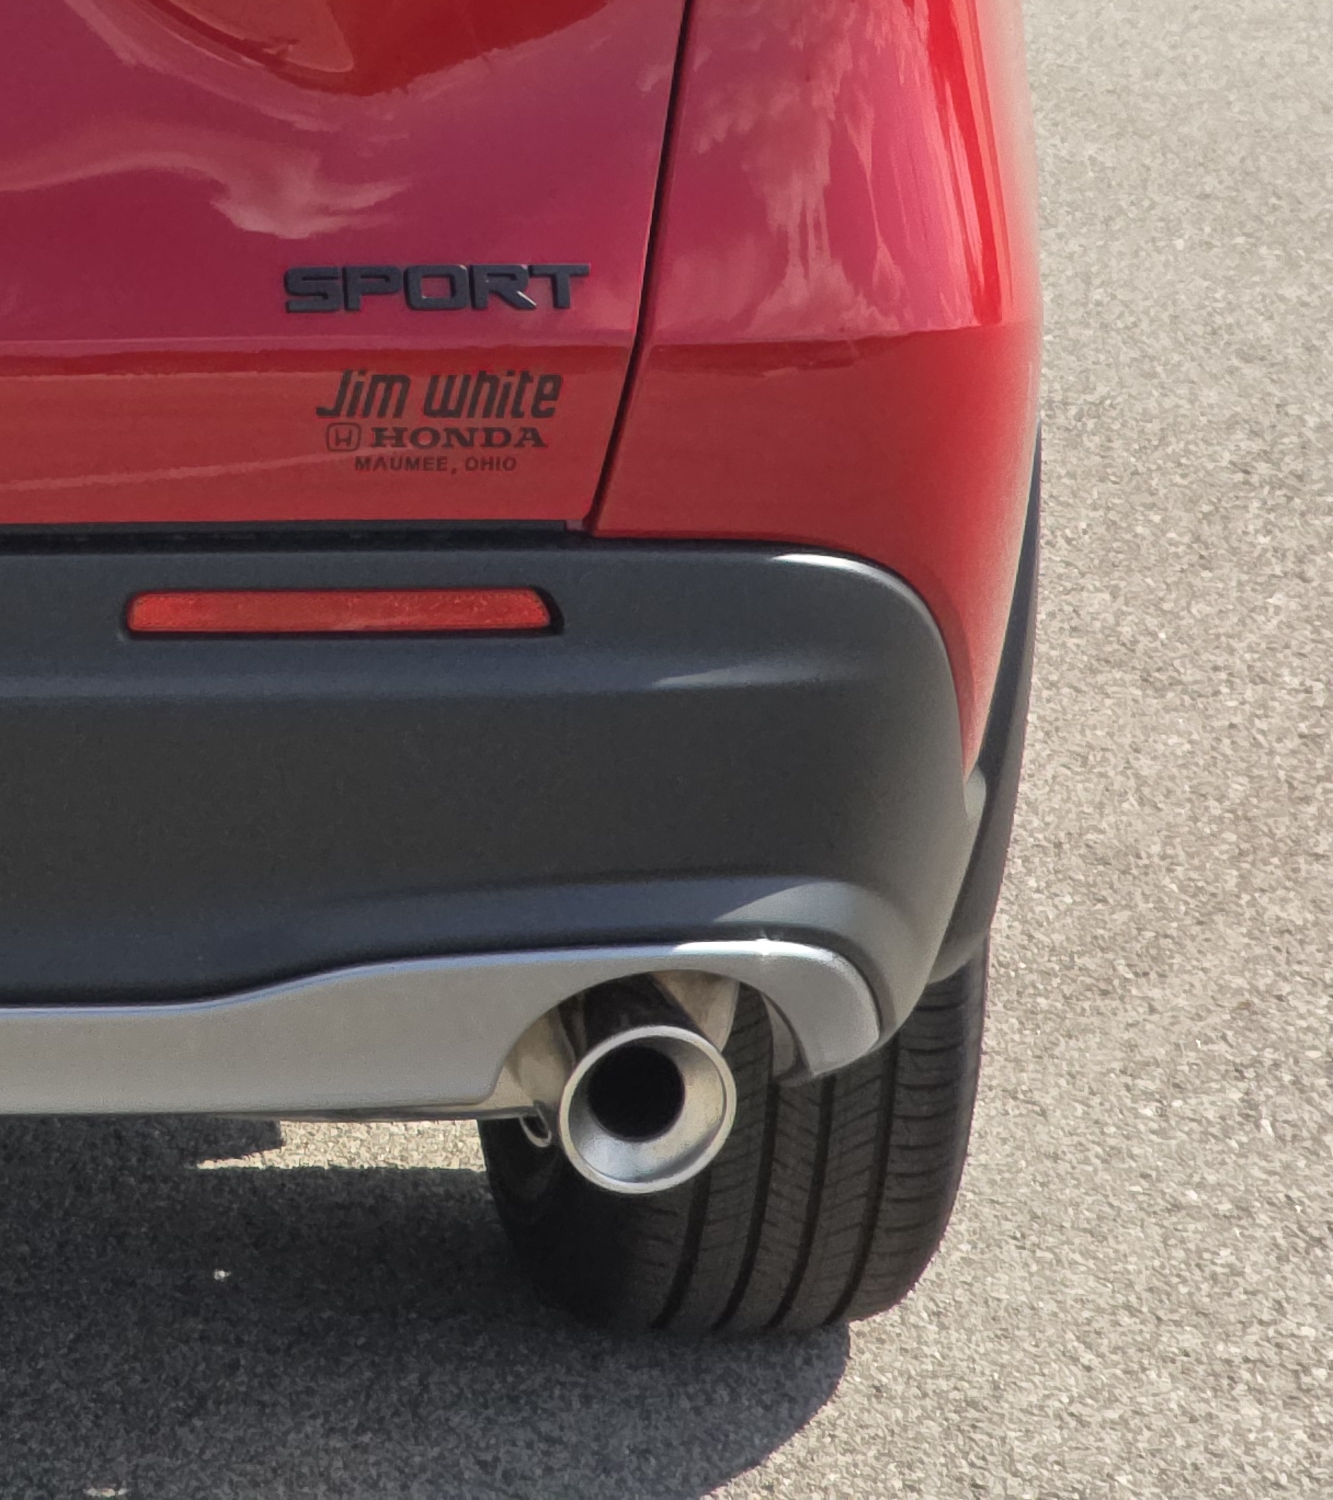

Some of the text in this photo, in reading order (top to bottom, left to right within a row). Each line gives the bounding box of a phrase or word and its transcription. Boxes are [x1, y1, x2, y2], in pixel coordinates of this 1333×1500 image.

[283, 263, 591, 313] SPORT
[371, 426, 548, 448] HONDA
[354, 455, 517, 476] MAUMEE, OHIO
